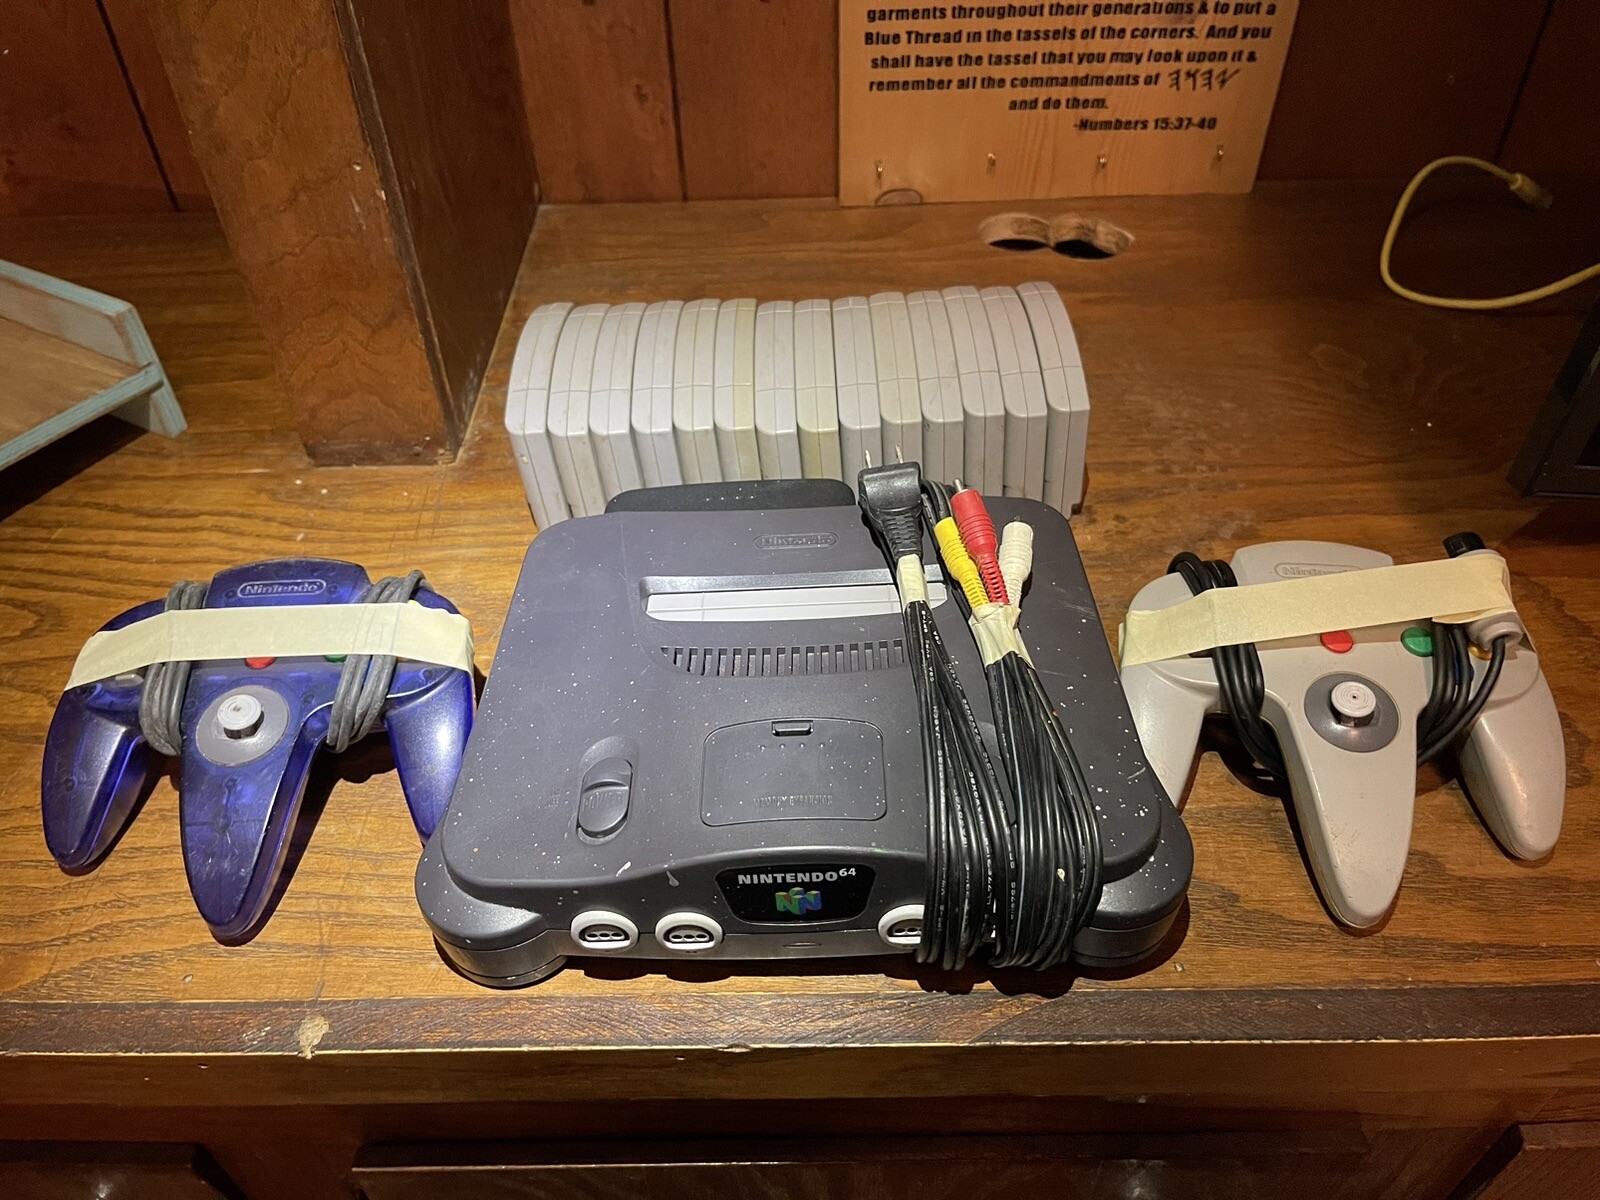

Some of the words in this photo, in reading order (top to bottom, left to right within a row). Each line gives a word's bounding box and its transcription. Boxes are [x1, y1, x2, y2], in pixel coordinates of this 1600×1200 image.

[867, 6, 947, 23] garments
[951, 3, 1044, 20] throughout
[1048, 1, 1088, 17] their
[1092, 0, 1194, 17] generations
[1197, 1, 1209, 15] &
[1213, 0, 1230, 15] to
[1233, 1, 1261, 16] put
[1265, 4, 1276, 15] a
[864, 31, 901, 45] Blue
[905, 29, 963, 44] Thread
[966, 29, 982, 43] in
[986, 28, 1013, 42] the
[1016, 26, 1076, 42] tassels
[1080, 26, 1097, 40] of
[1100, 26, 1126, 39] the
[1130, 26, 1199, 40] corners.
[1206, 25, 1239, 39] And
[1241, 26, 1272, 40] you
[870, 54, 911, 69] shall
[914, 54, 953, 68] have
[957, 54, 983, 67] the
[987, 51, 1037, 67] tassel
[1040, 51, 1074, 65] that
[1077, 51, 1106, 65] you
[1109, 51, 1143, 66] may
[1146, 49, 1183, 63] look
[1186, 50, 1228, 64] upon
[1231, 50, 1244, 63] it
[1246, 51, 1257, 63] &
[868, 78, 952, 92] remember
[956, 77, 977, 90] all
[980, 76, 1006, 90] the
[1009, 73, 1140, 88] commandments
[1143, 73, 1160, 86] of
[1007, 98, 1038, 111] and
[1041, 98, 1061, 110] do
[1065, 97, 1109, 109] them.
[1073, 117, 1149, 131] -Numbers
[1152, 117, 1218, 131] 15:37-40
[244, 582, 317, 594] Nintendo
